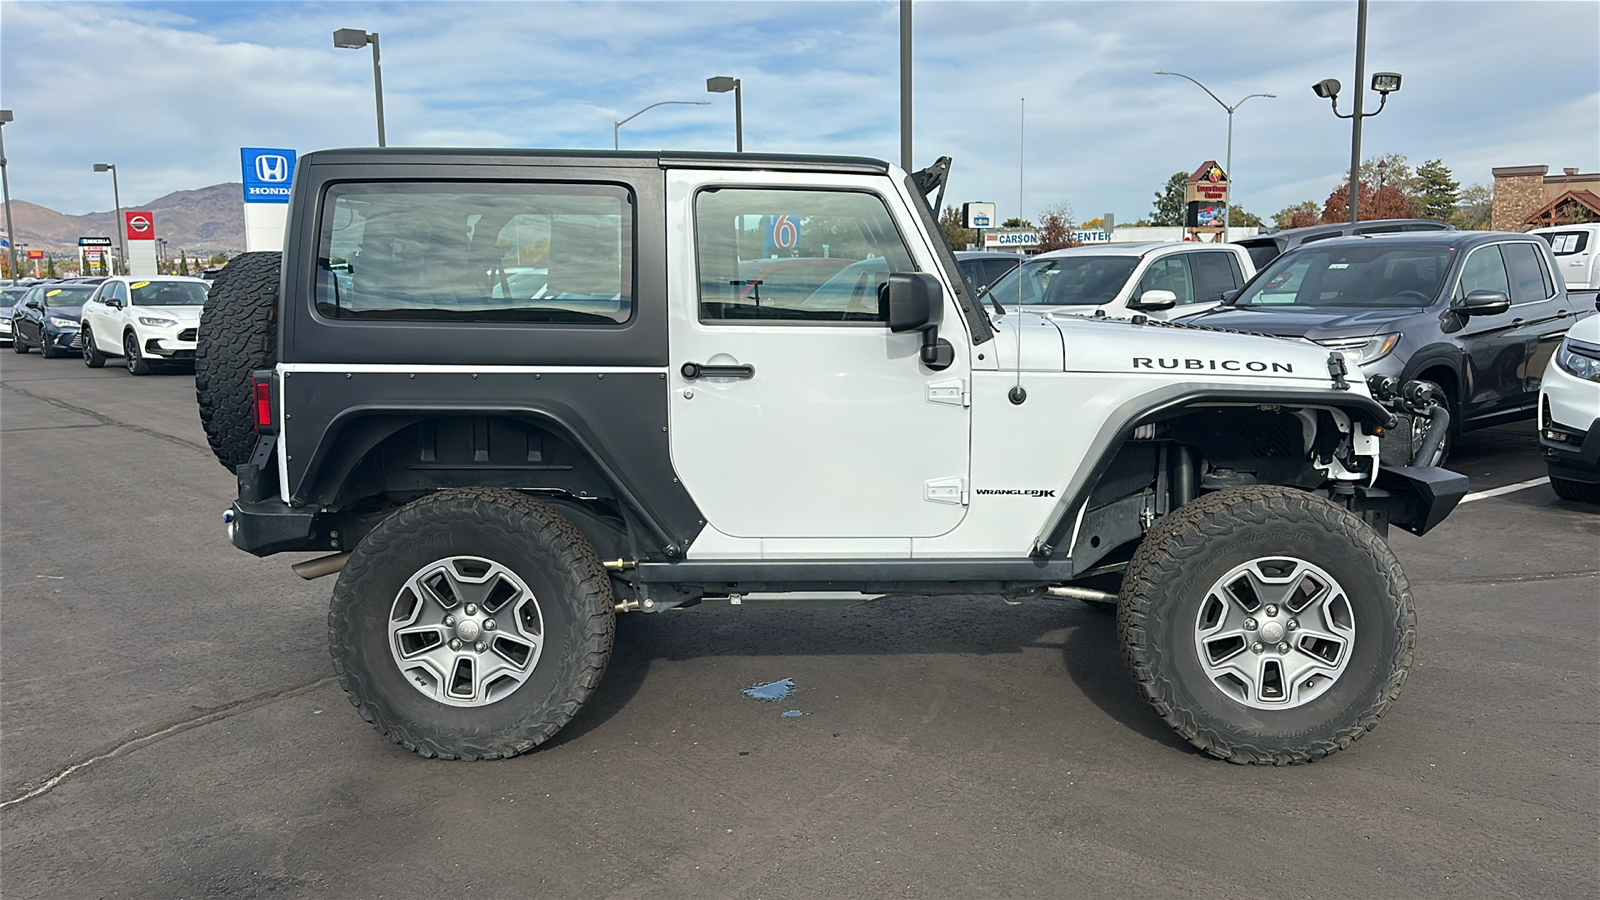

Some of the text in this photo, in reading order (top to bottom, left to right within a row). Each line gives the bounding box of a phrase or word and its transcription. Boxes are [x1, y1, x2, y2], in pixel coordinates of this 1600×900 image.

[773, 214, 798, 248] 6
[998, 234, 1037, 244] CARSON
[1132, 357, 1293, 373] RUBICON
